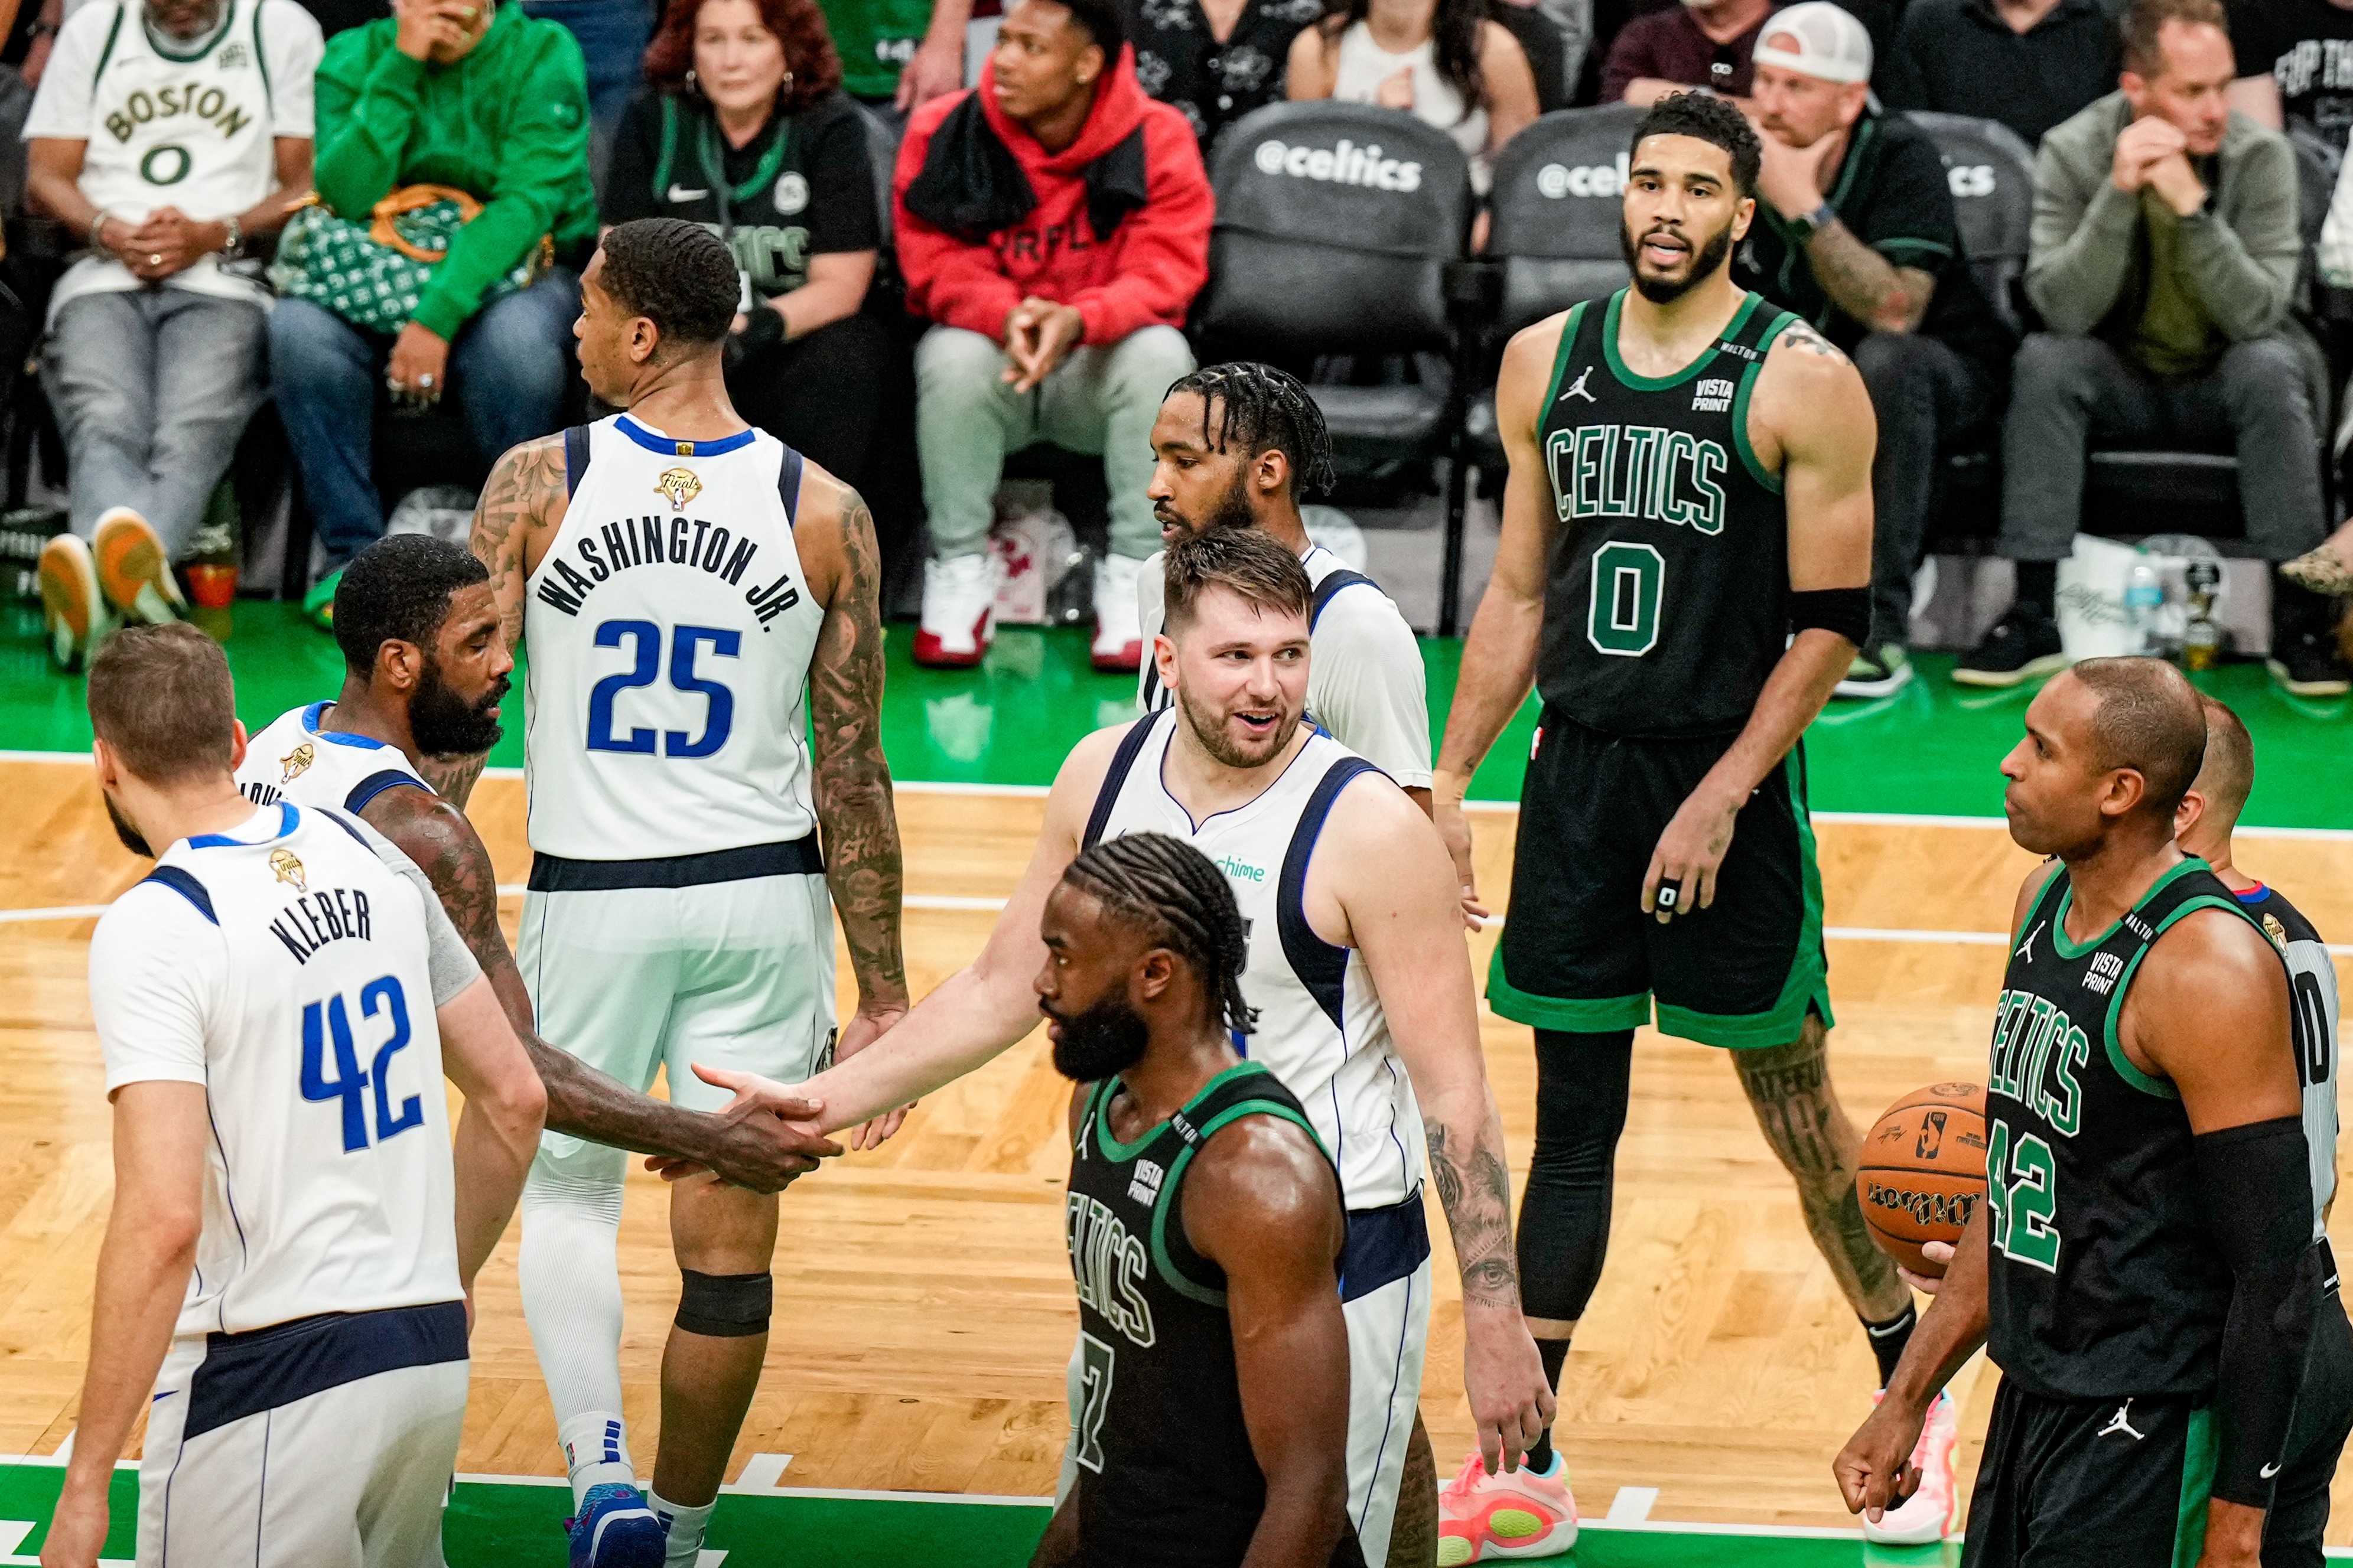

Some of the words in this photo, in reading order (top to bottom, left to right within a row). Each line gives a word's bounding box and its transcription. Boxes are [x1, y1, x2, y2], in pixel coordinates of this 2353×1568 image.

[106, 83, 252, 144] BOSTON
[1255, 139, 1421, 193] @celtics
[1537, 152, 1630, 200] @cel
[1720, 341, 1758, 360] WALTON
[1691, 397, 1732, 412] PRINT
[1695, 379, 1734, 399] VISTA
[660, 472, 701, 490] Finals
[1546, 425, 1727, 536] CELTICS
[537, 516, 758, 617] WASHINGTON
[746, 574, 800, 633] JR.
[1587, 540, 1665, 657] 0
[585, 618, 743, 759] 25
[1658, 887, 1677, 906] 0
[269, 888, 371, 966] KLEBER
[2081, 971, 2114, 996] PRINT
[2090, 952, 2124, 980] VISTA
[300, 973, 425, 1155] 42
[1127, 1179, 1158, 1208] PRINT
[1133, 1159, 1164, 1192] VISTA
[1986, 1118, 2061, 1274] 42
[1076, 1329, 1115, 1475] 7
